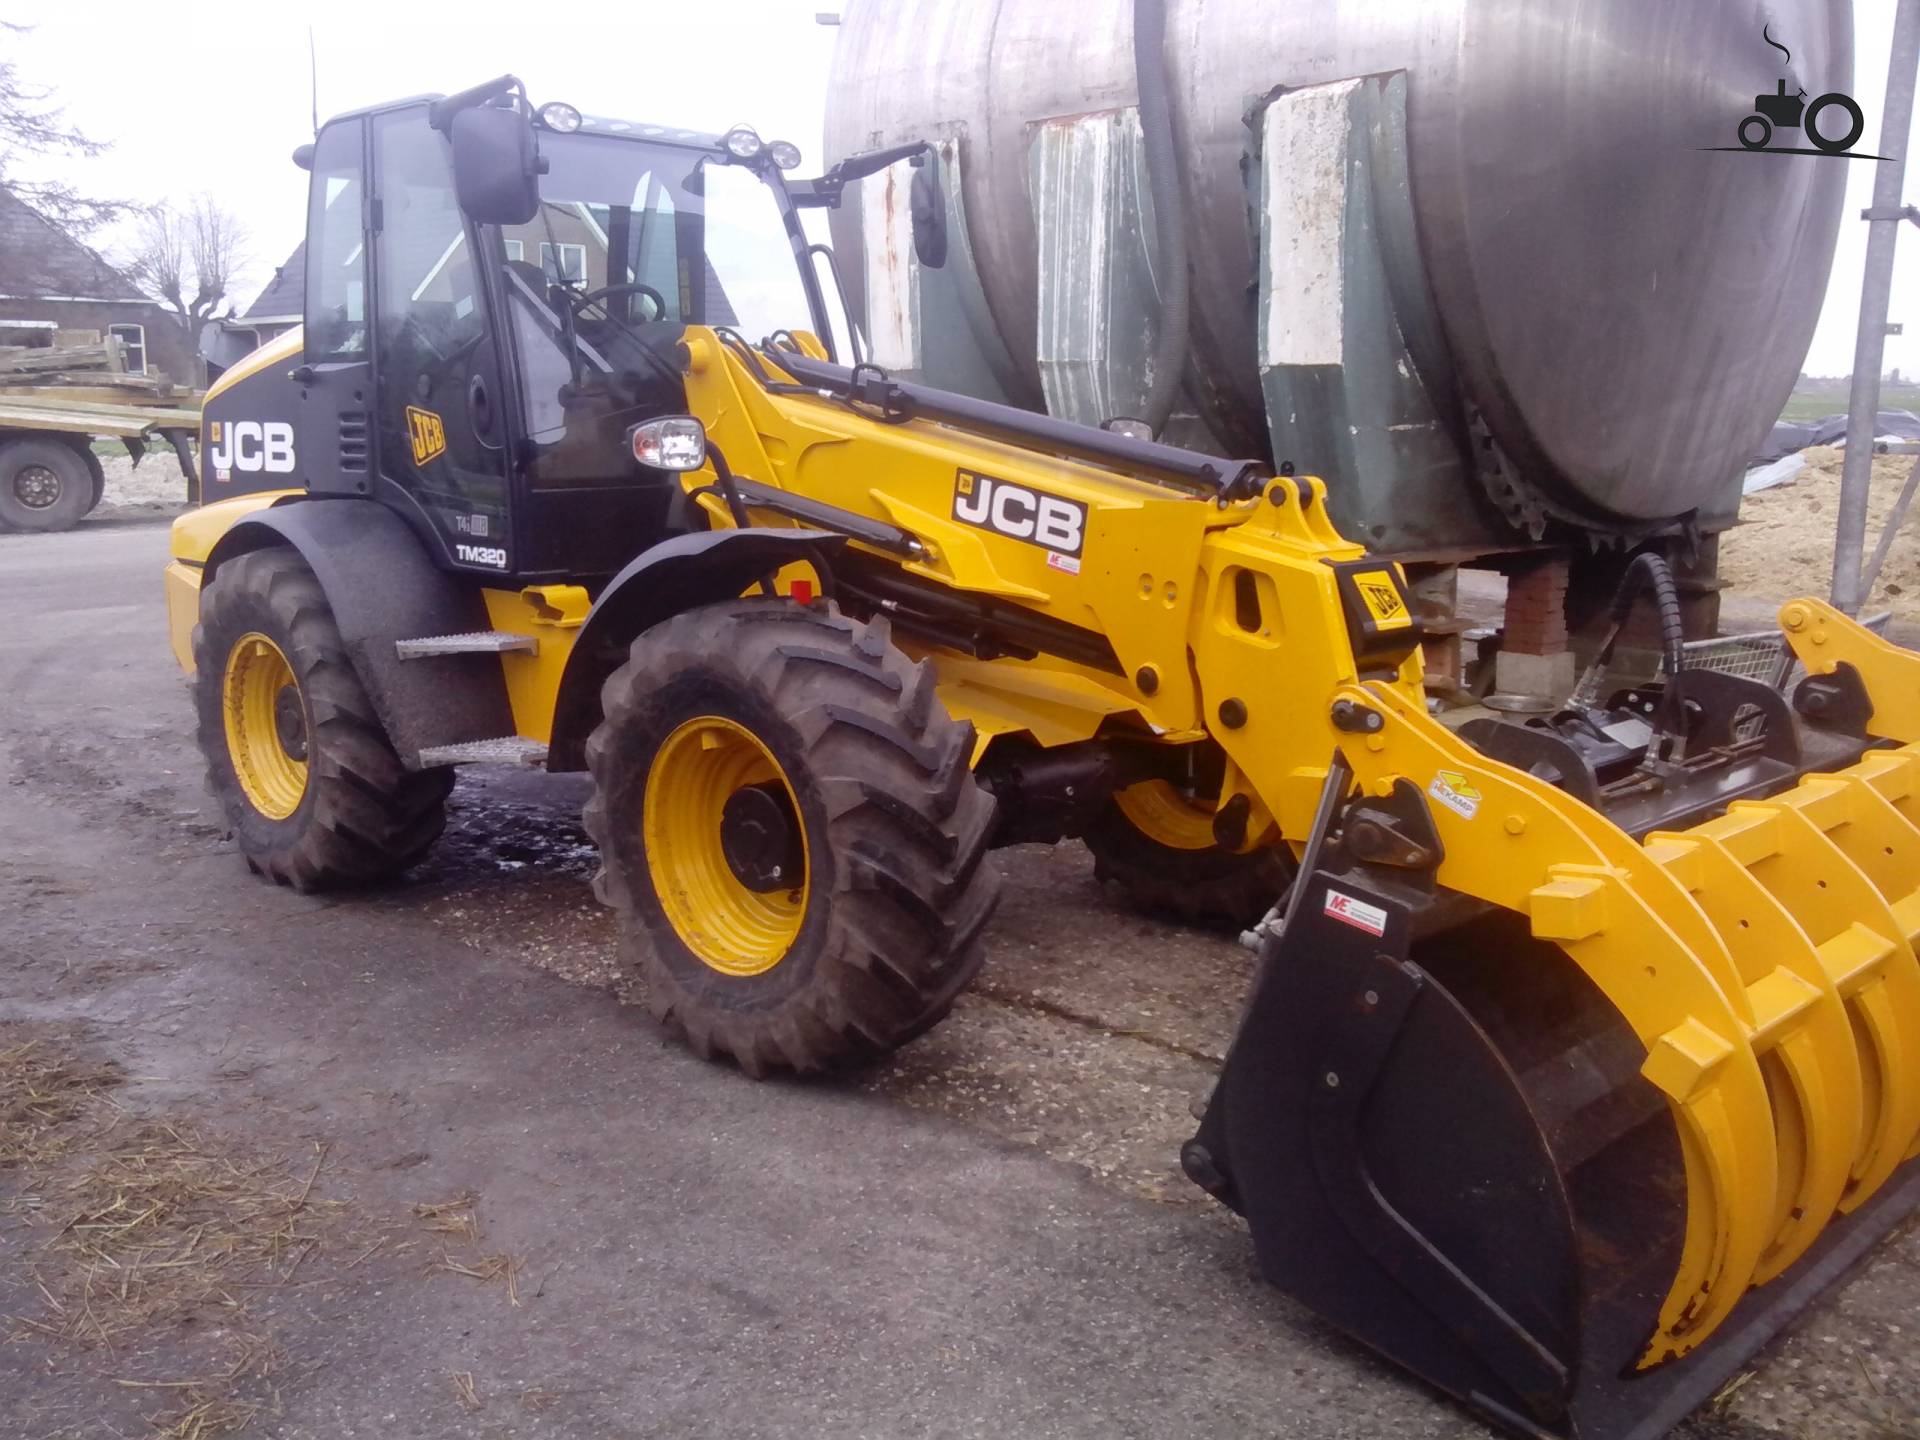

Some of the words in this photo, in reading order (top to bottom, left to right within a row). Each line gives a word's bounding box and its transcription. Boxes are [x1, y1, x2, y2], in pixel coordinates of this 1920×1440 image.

[212, 421, 296, 473] JCB
[413, 413, 443, 459] JCB
[955, 478, 1083, 552] JCB
[456, 544, 506, 565] TM320
